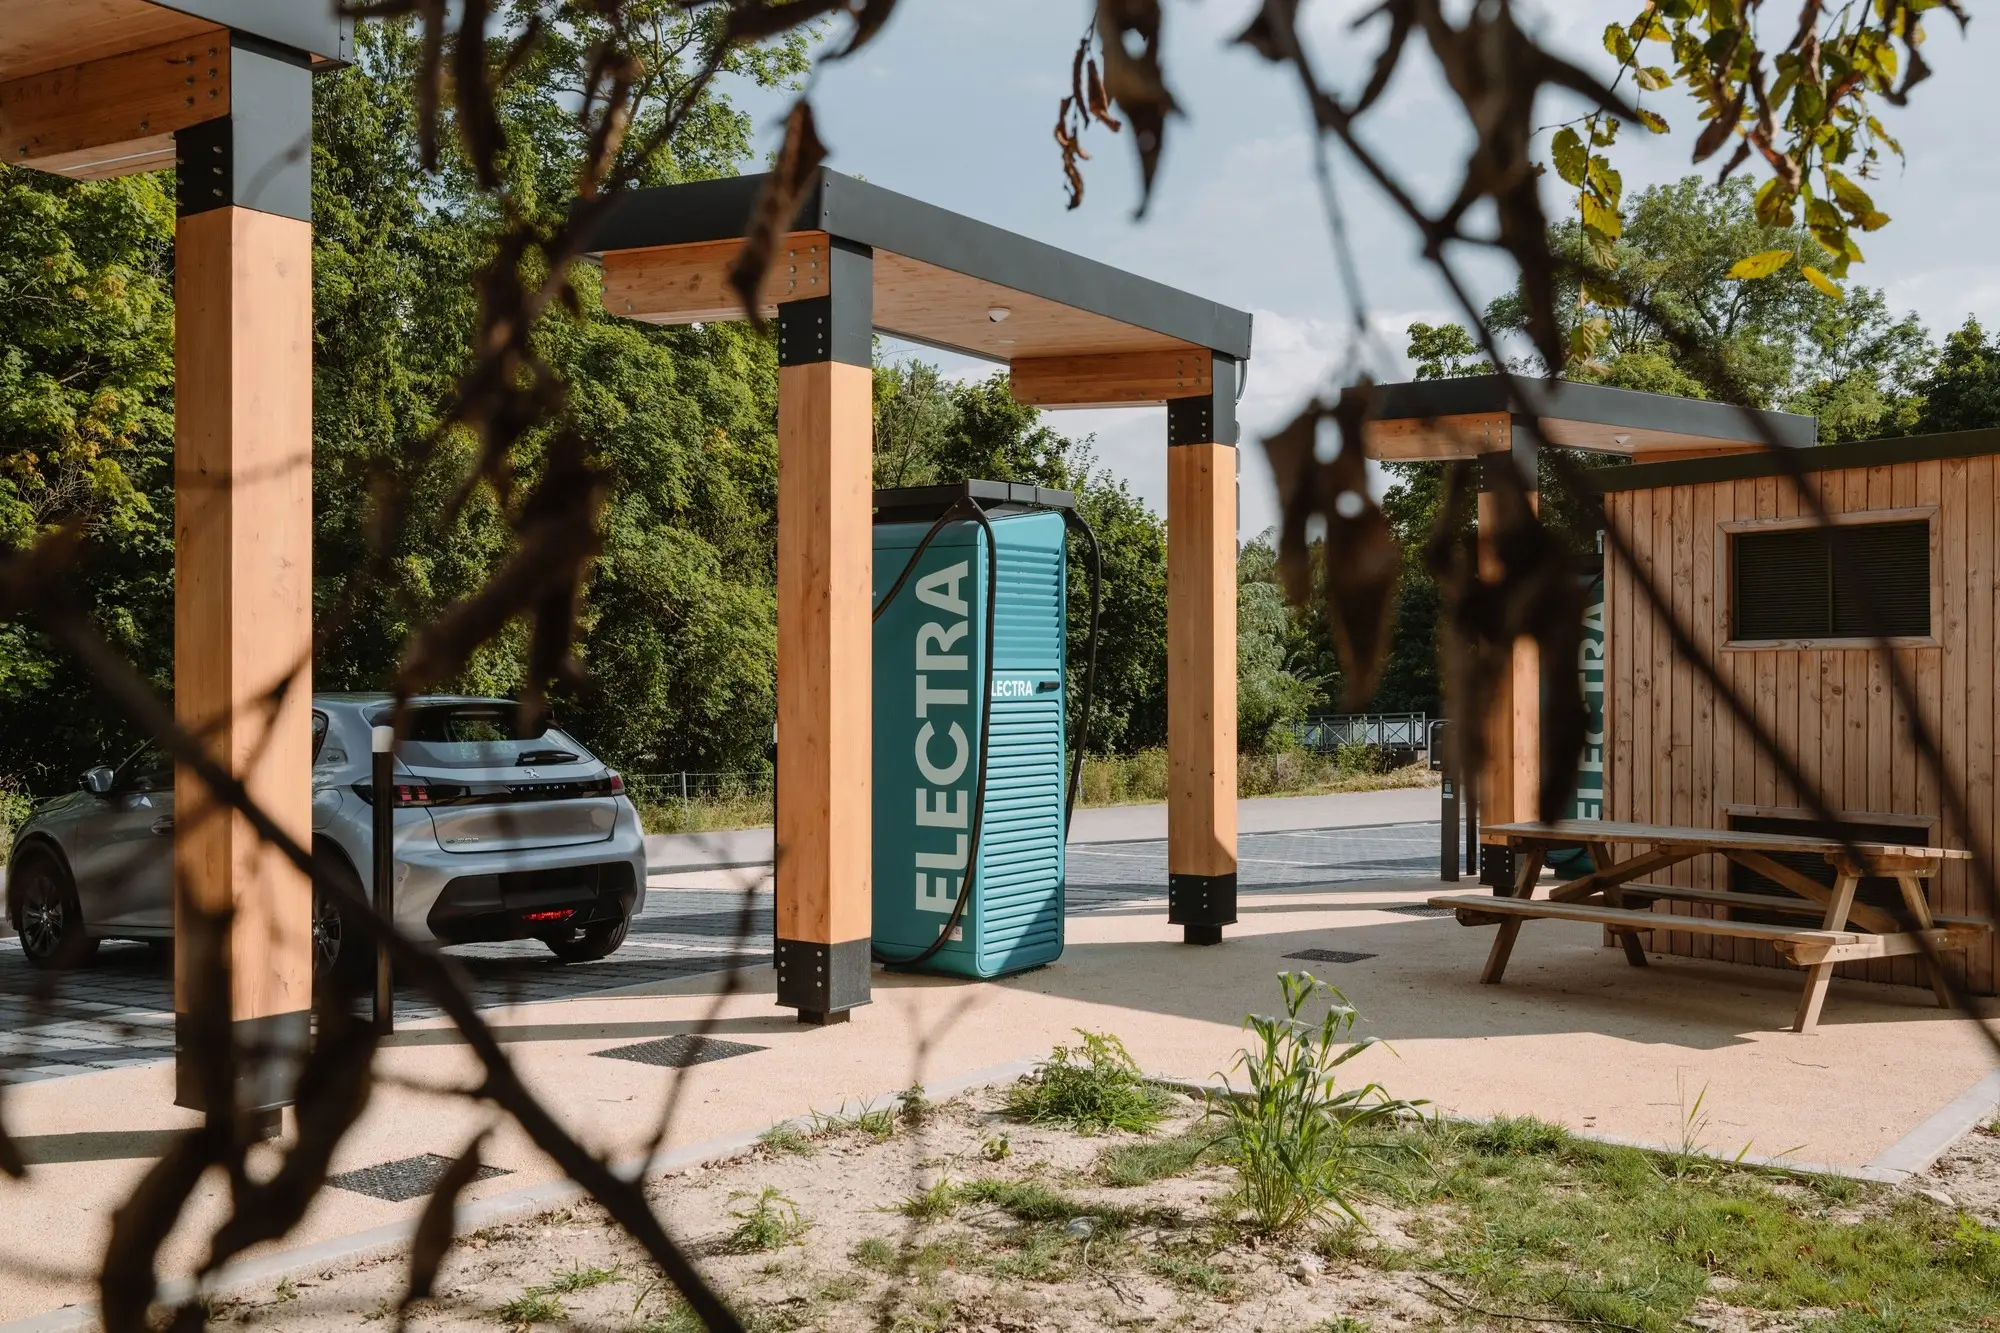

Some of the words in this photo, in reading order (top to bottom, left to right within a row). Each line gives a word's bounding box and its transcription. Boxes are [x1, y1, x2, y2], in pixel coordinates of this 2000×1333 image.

[990, 680, 1033, 697] LECTRA
[915, 560, 969, 916] ELECTRA
[511, 784, 567, 792] PEUEOT
